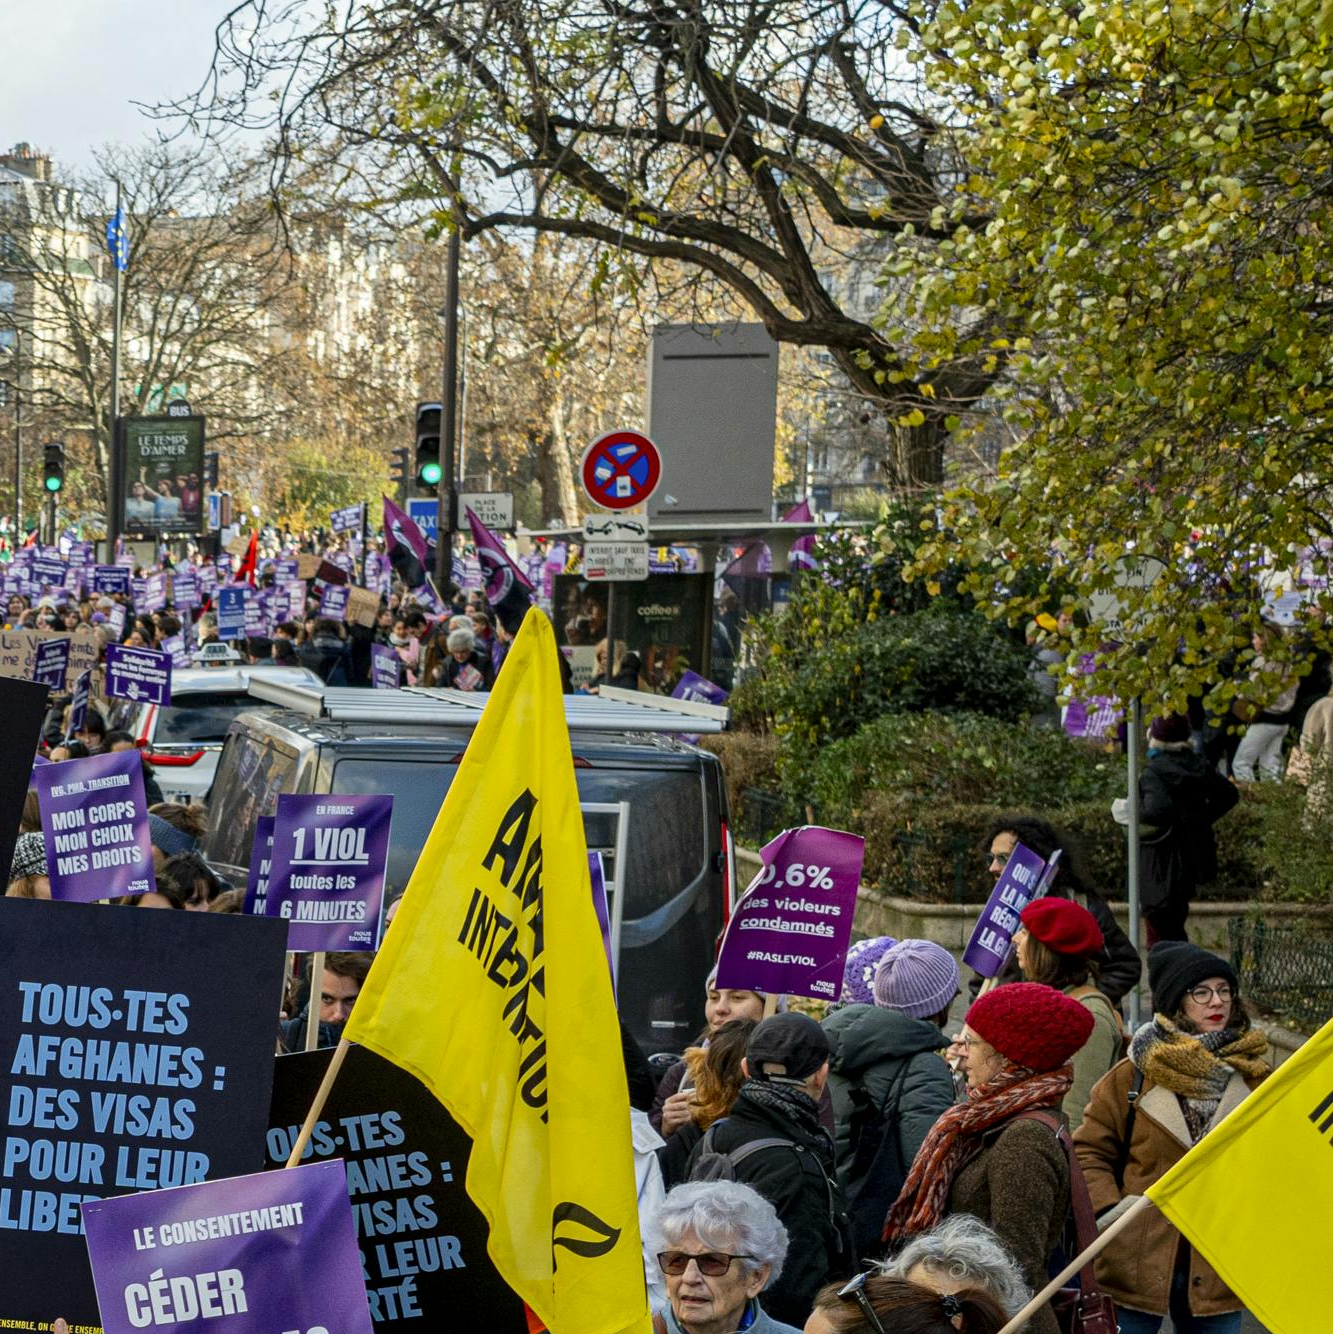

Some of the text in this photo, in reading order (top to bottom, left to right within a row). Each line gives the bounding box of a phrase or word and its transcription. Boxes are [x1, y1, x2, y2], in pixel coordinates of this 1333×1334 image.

[170, 406, 189, 416] BUS
[138, 435, 188, 446] LE TEMPS
[464, 513, 507, 521] NTION
[2, 633, 22, 650] Les
[52, 800, 135, 830] MON CORPS
[327, 805, 354, 815] FRANCE
[54, 824, 134, 854] MON CHOIX
[293, 827, 369, 860] 1 VIOL
[57, 847, 142, 876] MES DROITS
[290, 873, 356, 890] toutes les
[1012, 863, 1031, 885] QUI
[280, 900, 366, 921] 6 MINUTES
[743, 897, 841, 916] des violeurs
[740, 917, 834, 936] condamnés
[747, 951, 817, 967] #RASLEVIOL
[11, 1034, 203, 1090] AFGHANES
[8, 1086, 196, 1140] DES VISAS
[3, 1137, 102, 1186] POUR
[133, 1202, 304, 1250] LE CONSENTEMENT
[376, 1235, 466, 1279] LEUR
[124, 1268, 248, 1328] CÉDER
